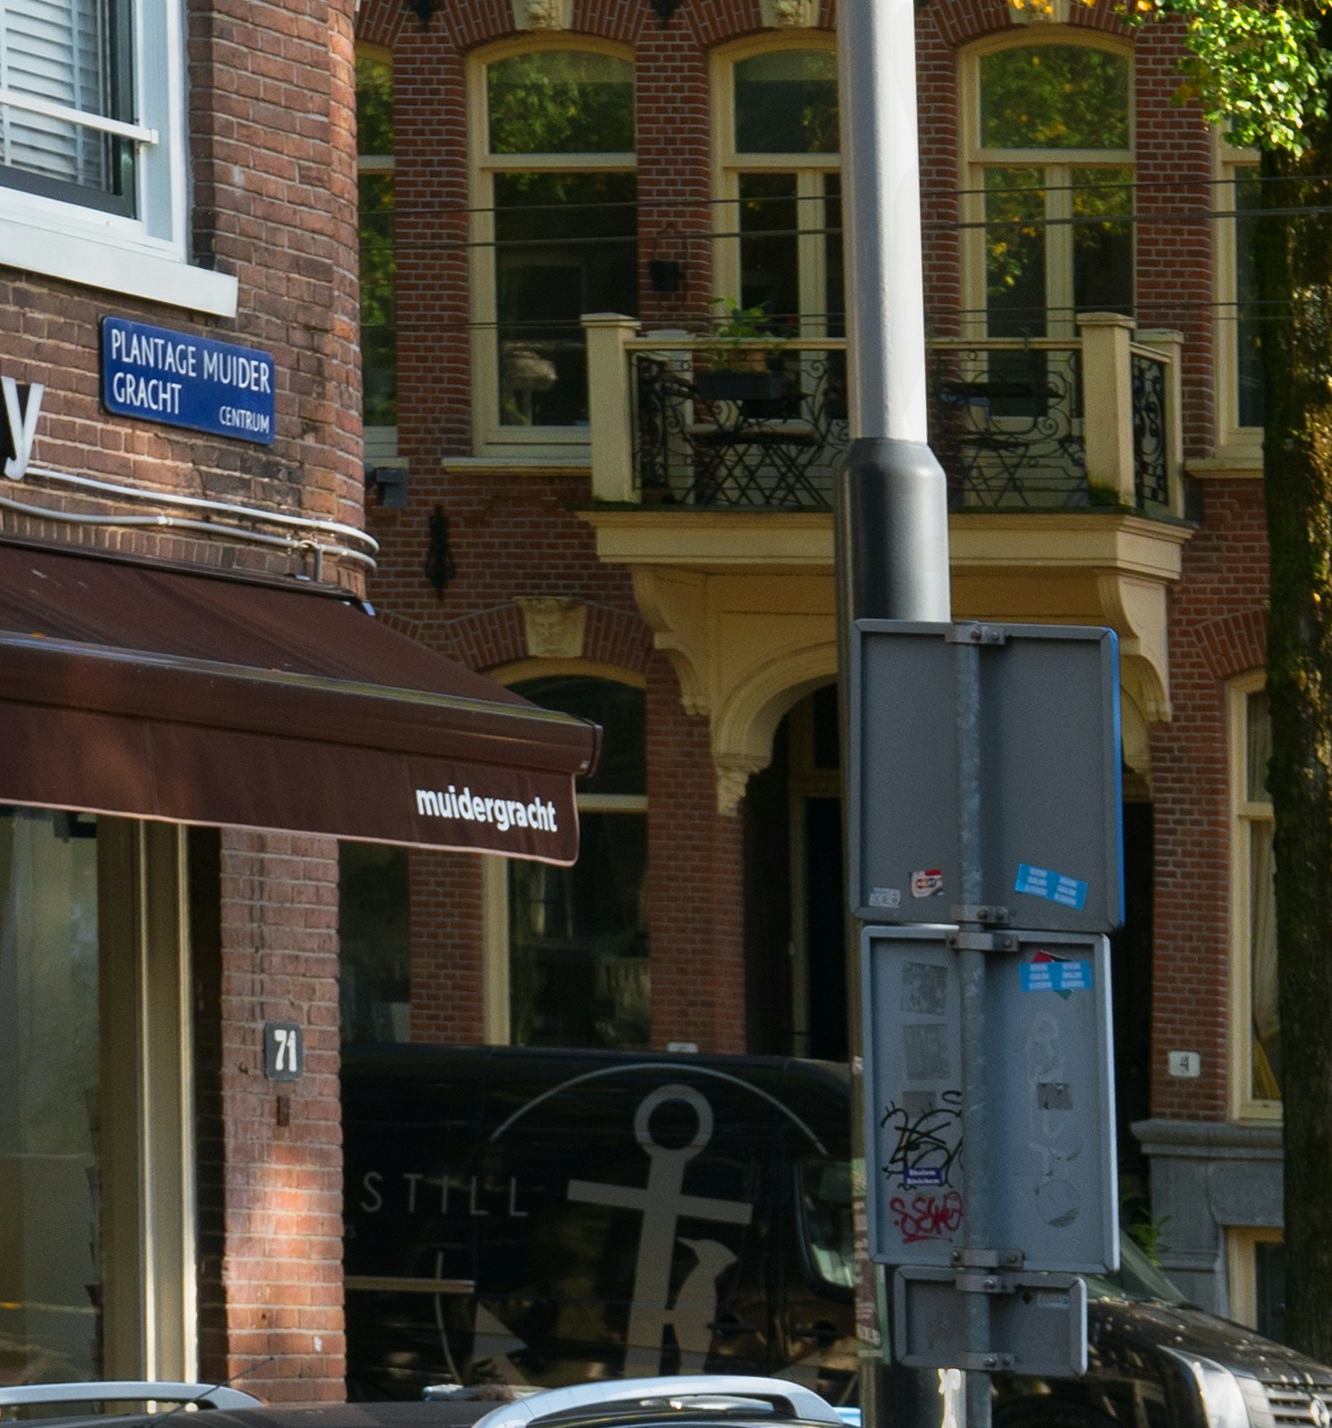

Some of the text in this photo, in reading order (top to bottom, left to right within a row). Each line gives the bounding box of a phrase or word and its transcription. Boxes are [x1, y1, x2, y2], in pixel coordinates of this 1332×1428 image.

[111, 329, 271, 394] PLANTAGE MUIDER
[113, 372, 182, 414] GRACHT
[219, 406, 269, 433] CENTRUM
[416, 785, 557, 832] muidergracht
[274, 1029, 297, 1073] 71
[361, 1172, 528, 1216] STILL
